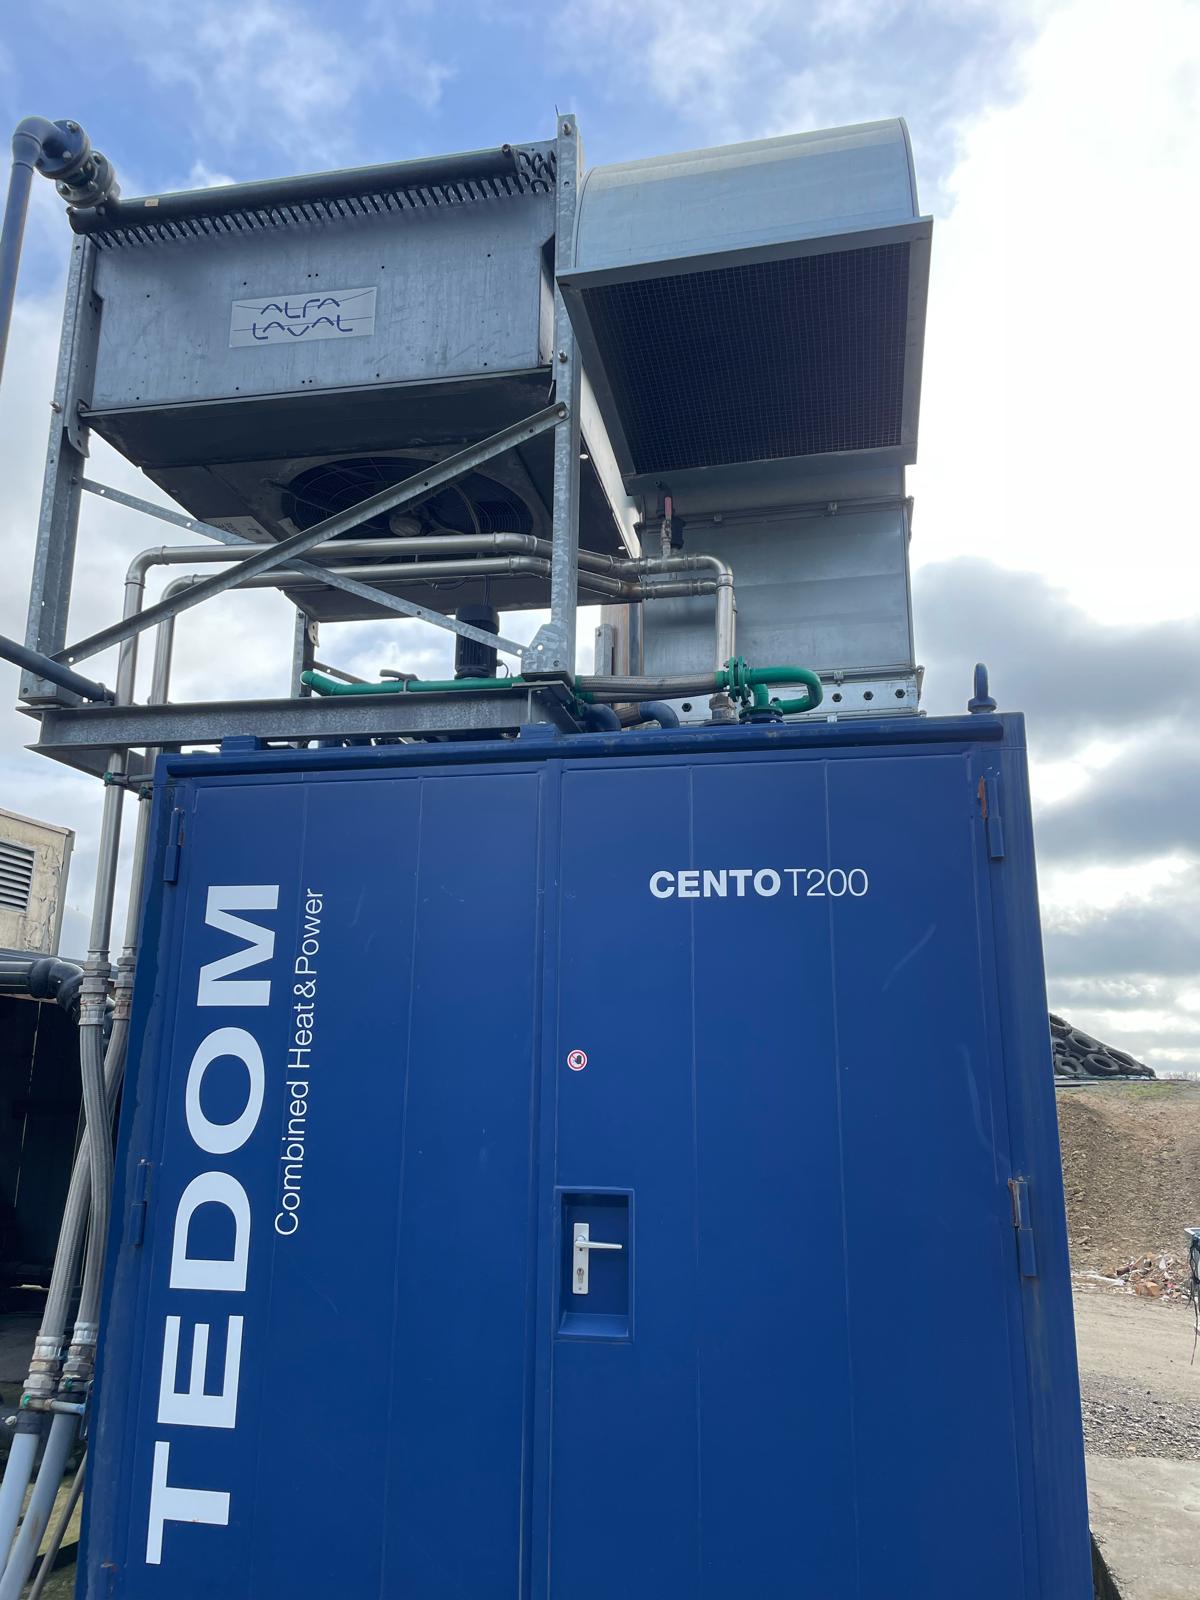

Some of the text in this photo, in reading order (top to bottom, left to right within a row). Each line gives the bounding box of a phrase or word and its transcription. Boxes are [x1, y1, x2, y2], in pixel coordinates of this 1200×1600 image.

[260, 298, 340, 318] ALFA
[252, 315, 353, 340] LAVAL
[649, 868, 869, 899] CENTO T200
[274, 1081, 309, 1236] Combined
[145, 884, 280, 1565] TEDOM
